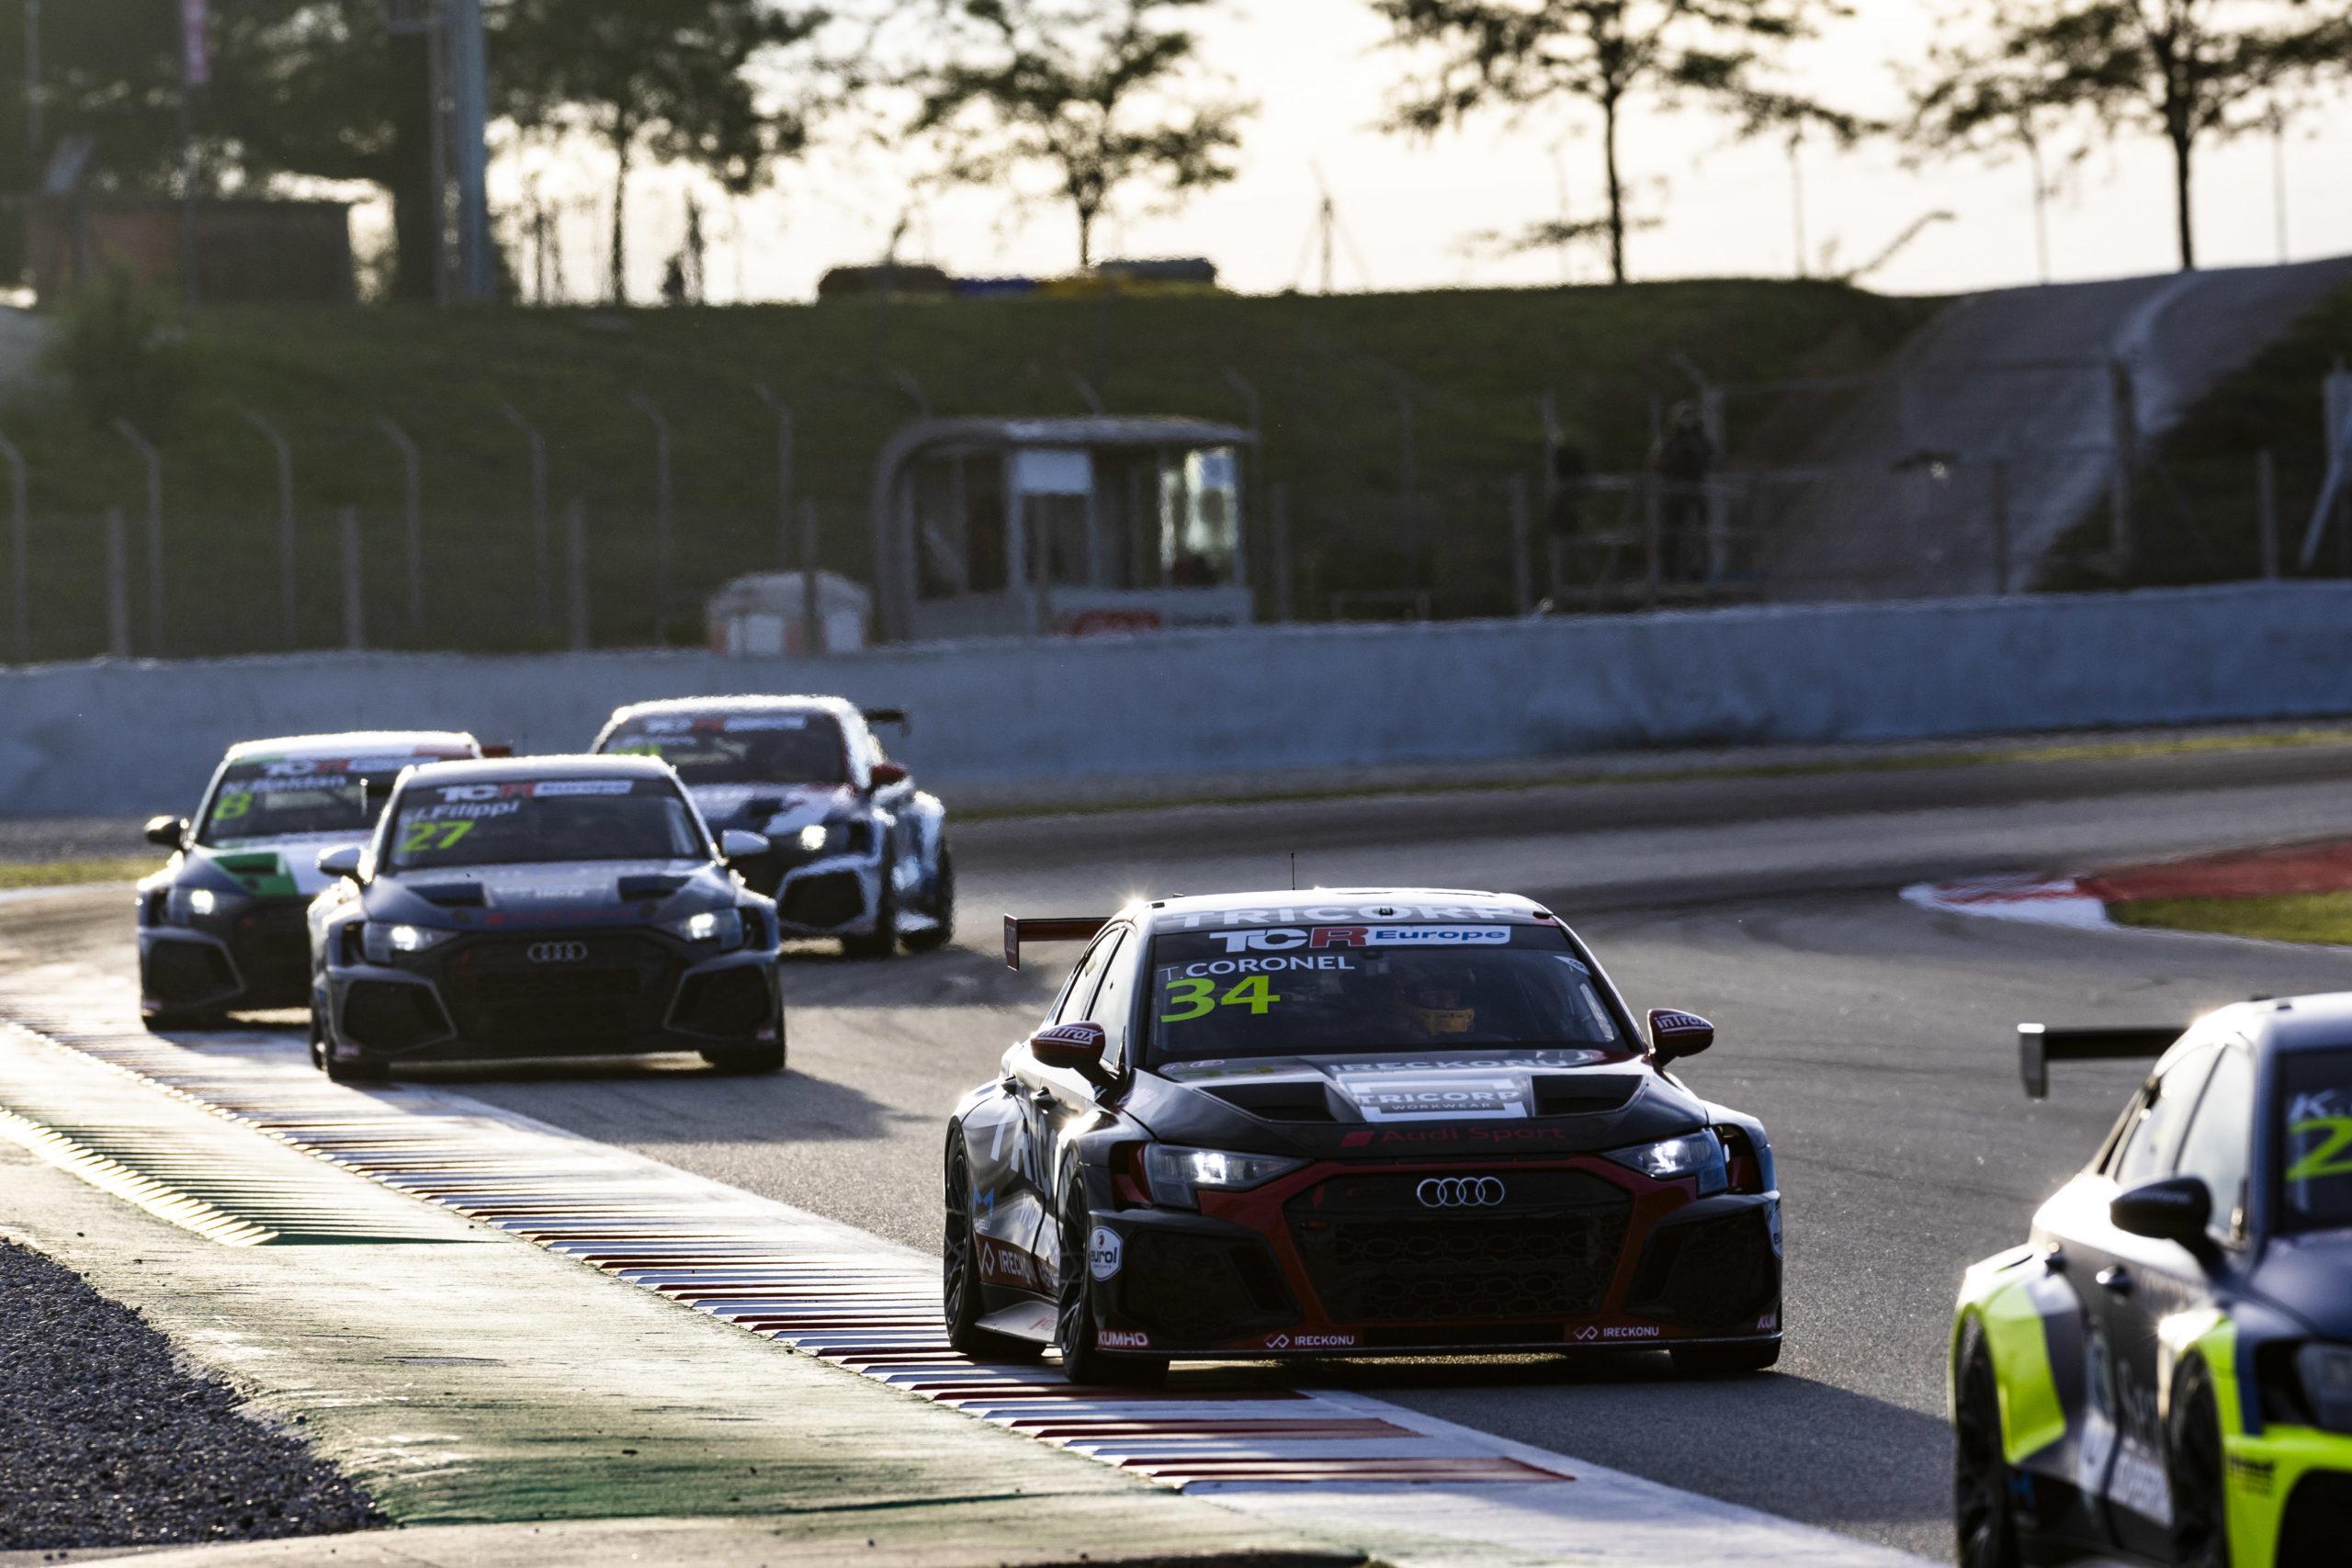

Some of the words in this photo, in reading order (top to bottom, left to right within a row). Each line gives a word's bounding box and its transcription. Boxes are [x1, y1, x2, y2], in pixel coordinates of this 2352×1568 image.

[214, 792, 253, 821] 8
[397, 820, 475, 852] 27
[1209, 927, 1370, 953] TCR
[1375, 929, 1507, 942] Europe
[1160, 975, 1281, 1022] 34
[1354, 1090, 1520, 1105] TRICORP
[1390, 1101, 1492, 1111] WORKWEAR
[1380, 1128, 1459, 1143] Audi
[1470, 1126, 1566, 1144] Sport
[1098, 1331, 1149, 1348] KUMHO
[1602, 1325, 1660, 1338] IRECKONU
[1295, 1335, 1355, 1347] IRECKONU
